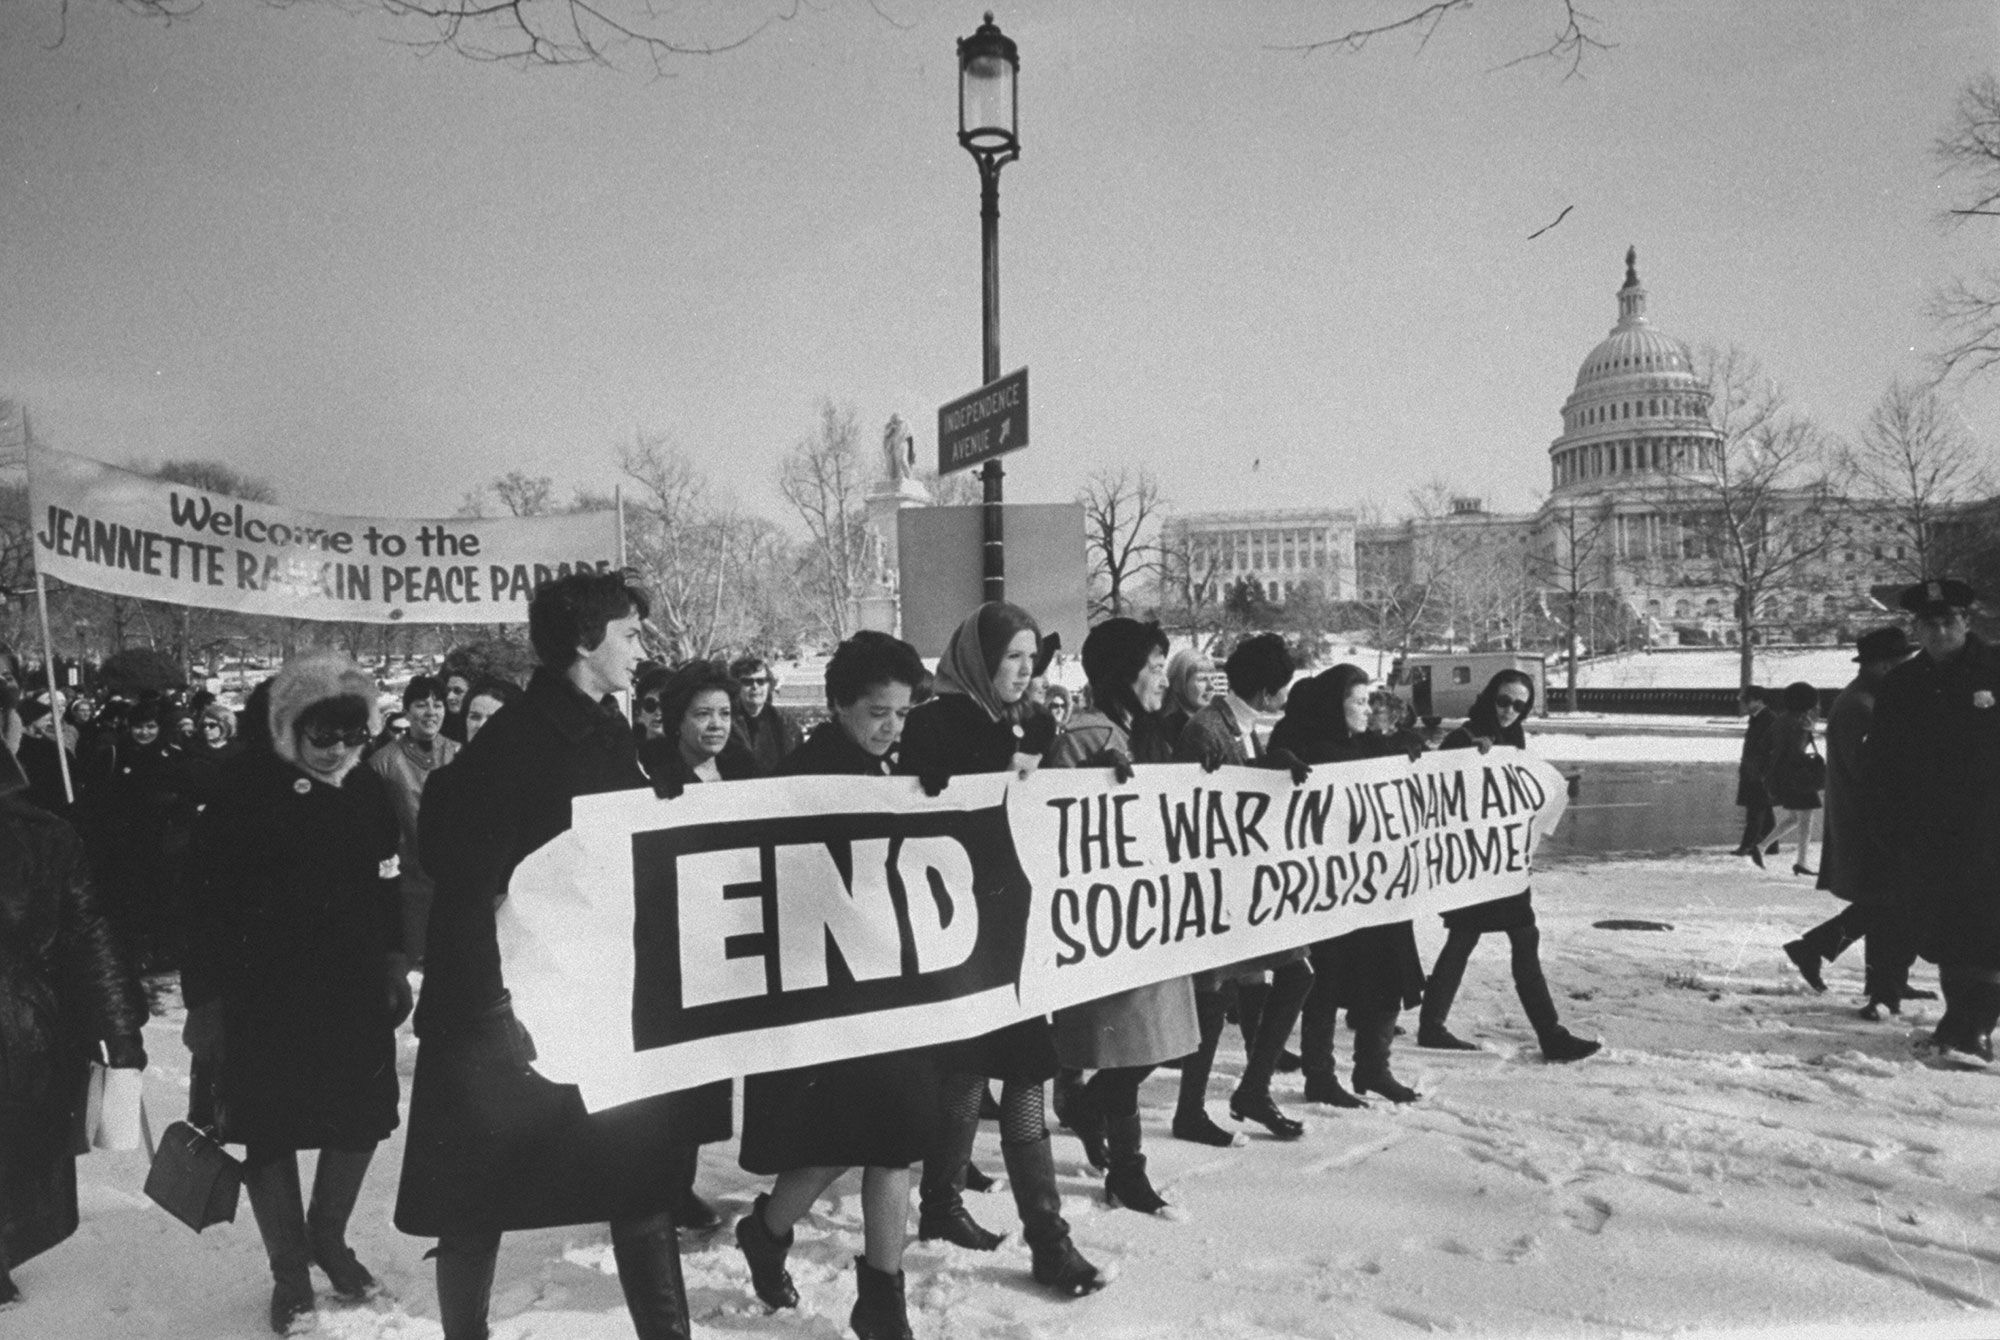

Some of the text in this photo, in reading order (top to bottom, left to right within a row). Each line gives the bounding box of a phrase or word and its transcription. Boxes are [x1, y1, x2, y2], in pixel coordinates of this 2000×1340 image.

[944, 383, 1020, 435] INDEPENDENCE
[952, 428, 990, 462] AVENUE
[37, 504, 225, 586] JEANNETTE
[382, 565, 481, 604] PEACE
[170, 491, 481, 557] Welcome to the
[1046, 763, 1546, 878] THE WAR IN VIETNAM AND
[675, 835, 979, 1010] END
[1050, 814, 1535, 968] SOCIAL CRISIS AT HOME!
